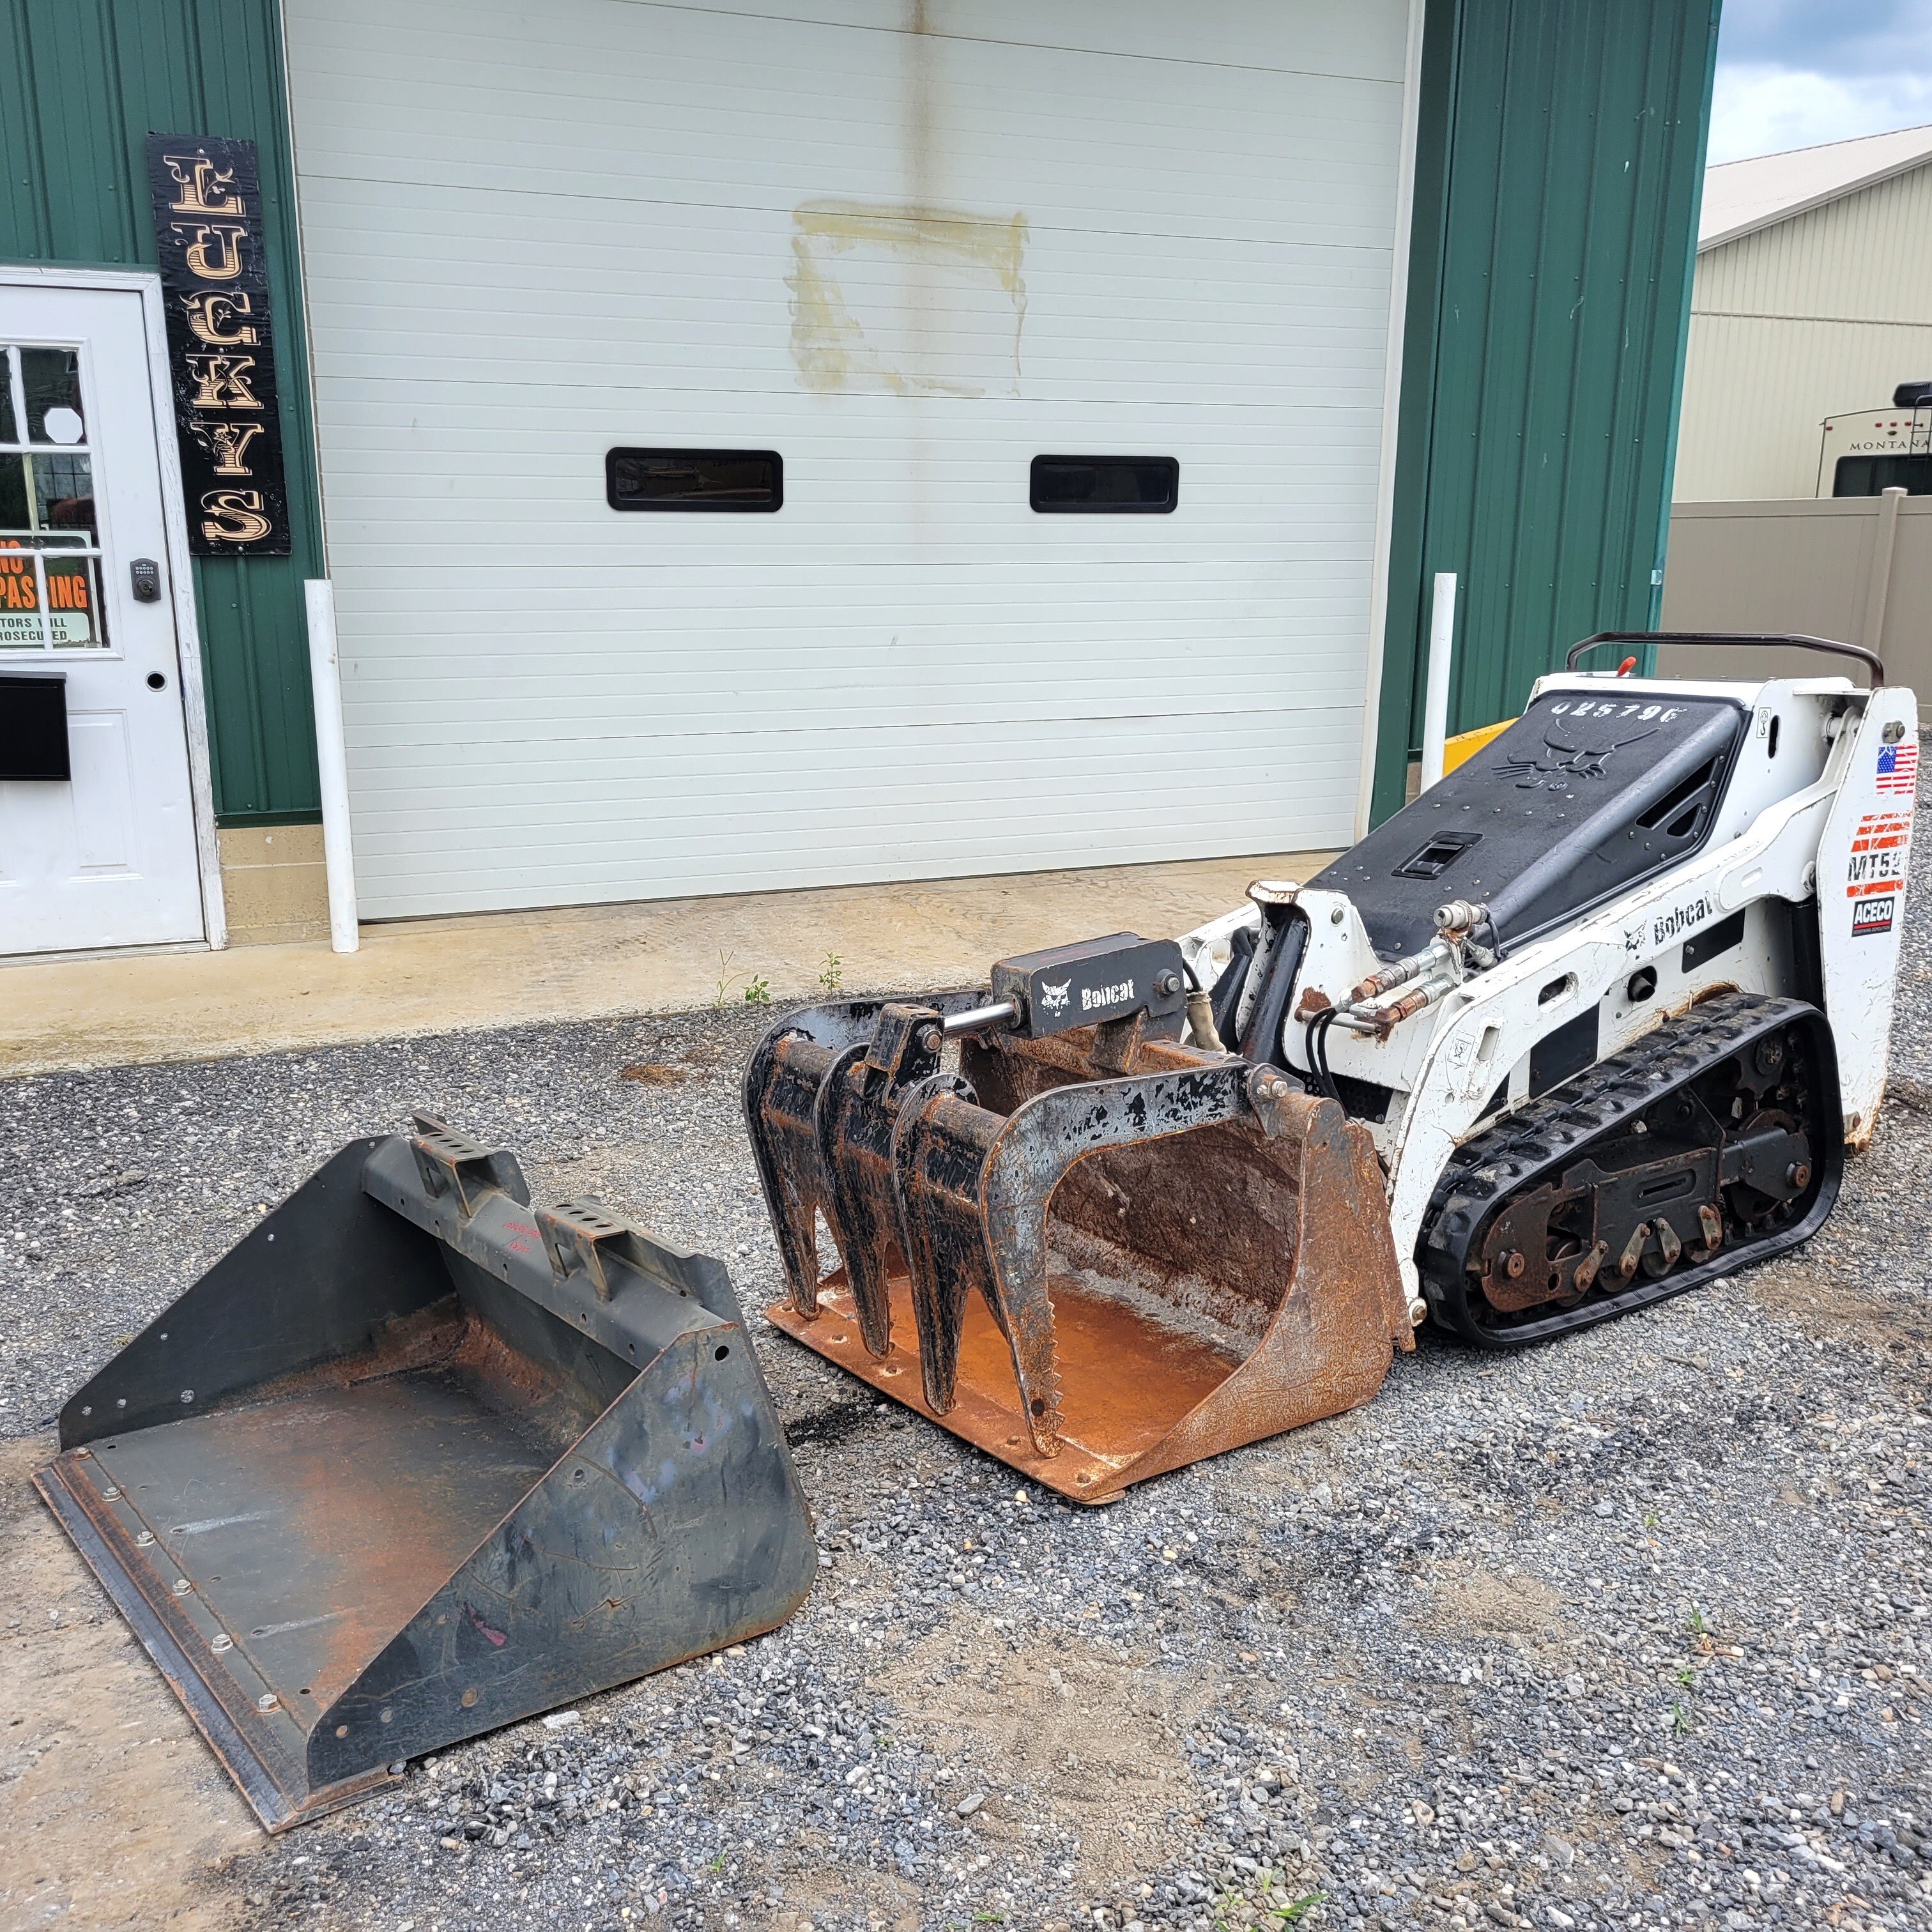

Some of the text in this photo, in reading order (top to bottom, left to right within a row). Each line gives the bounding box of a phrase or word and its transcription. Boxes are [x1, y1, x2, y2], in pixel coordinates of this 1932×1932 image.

[163, 155, 272, 542] LUCKYS
[1850, 440, 1931, 450] MONTANA
[0, 575, 88, 609] ASING
[0, 631, 67, 641] OSECUED
[1653, 891, 1713, 946] Bobcat
[1854, 900, 1893, 924] ACECO
[1082, 979, 1135, 1011] Bobcat
